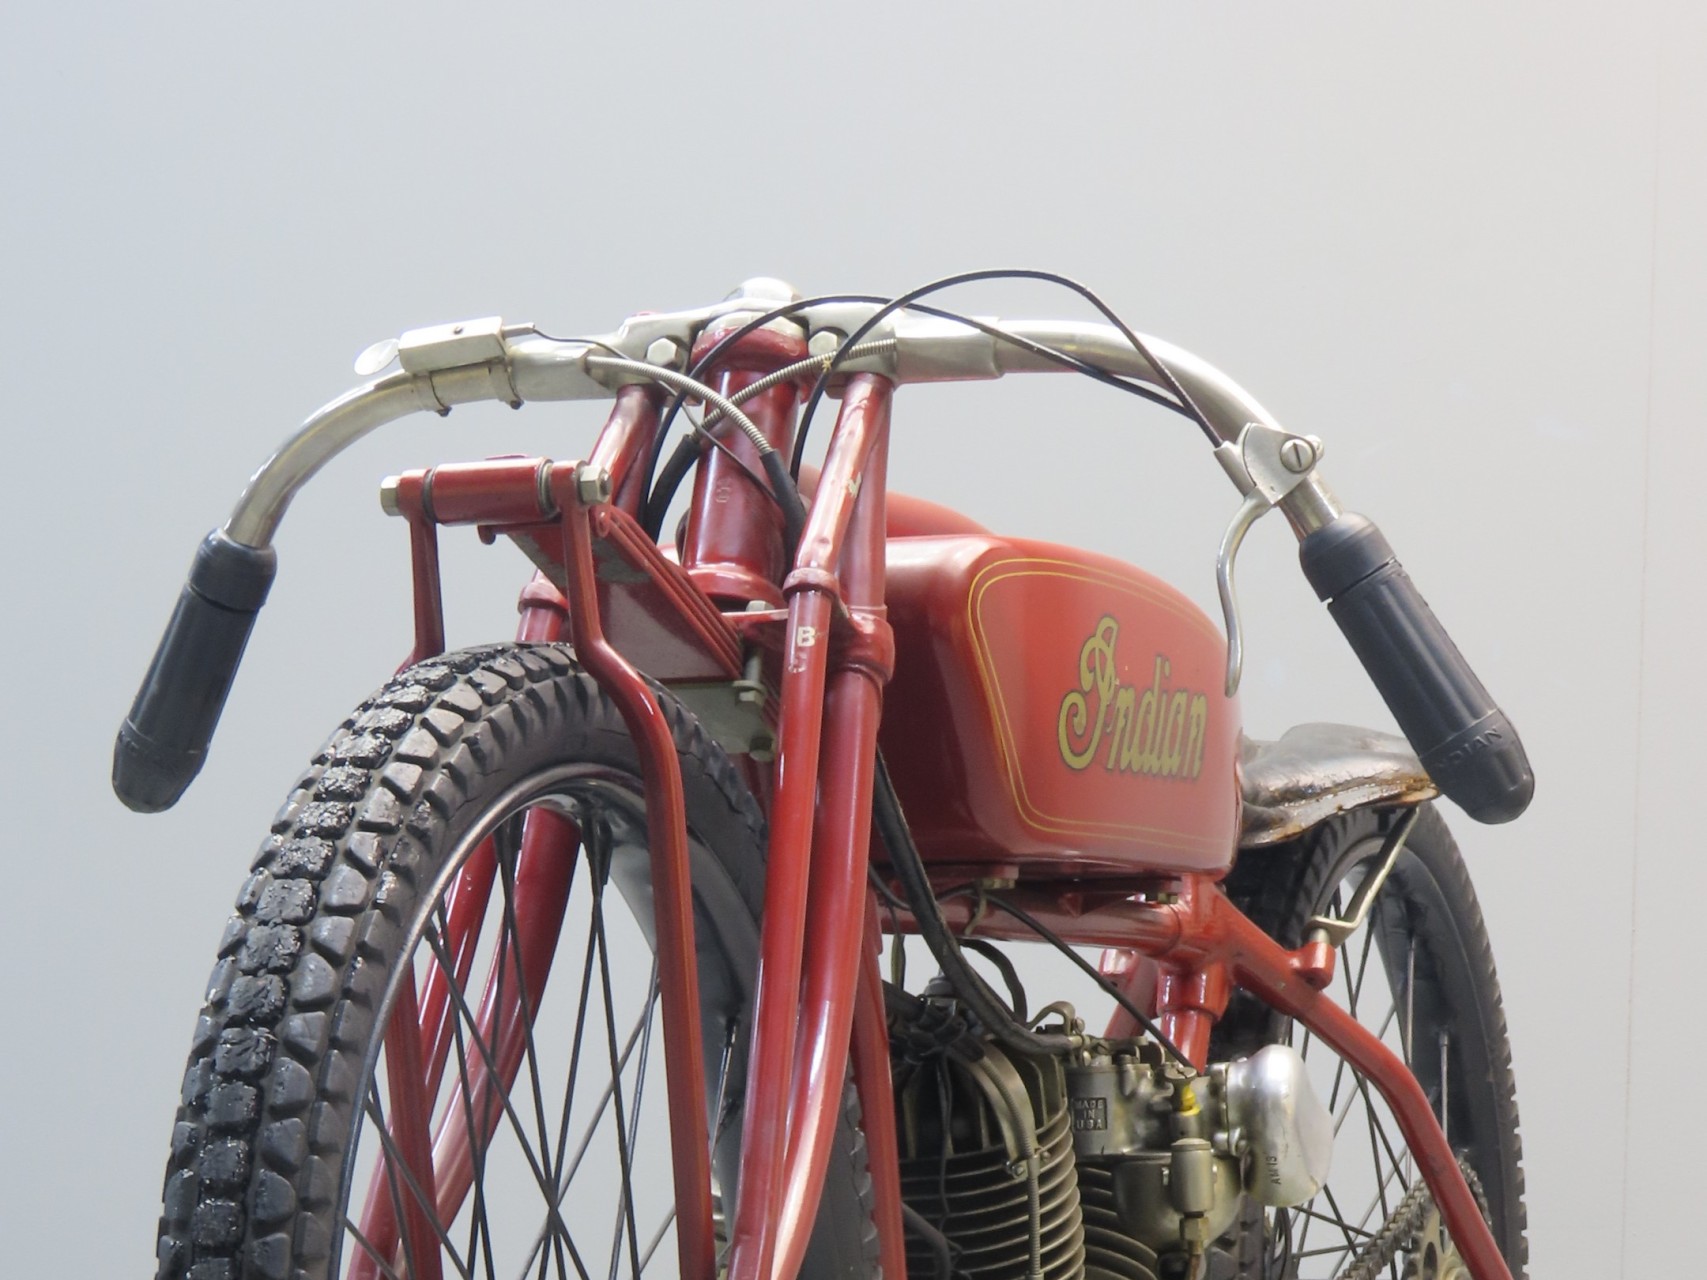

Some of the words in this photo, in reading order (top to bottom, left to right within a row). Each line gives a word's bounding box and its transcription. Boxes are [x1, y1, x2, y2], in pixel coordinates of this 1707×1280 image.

[796, 625, 816, 648] B
[1057, 613, 1208, 780] Indian
[1074, 1099, 1104, 1109] MADE
[1083, 1109, 1096, 1119] IN
